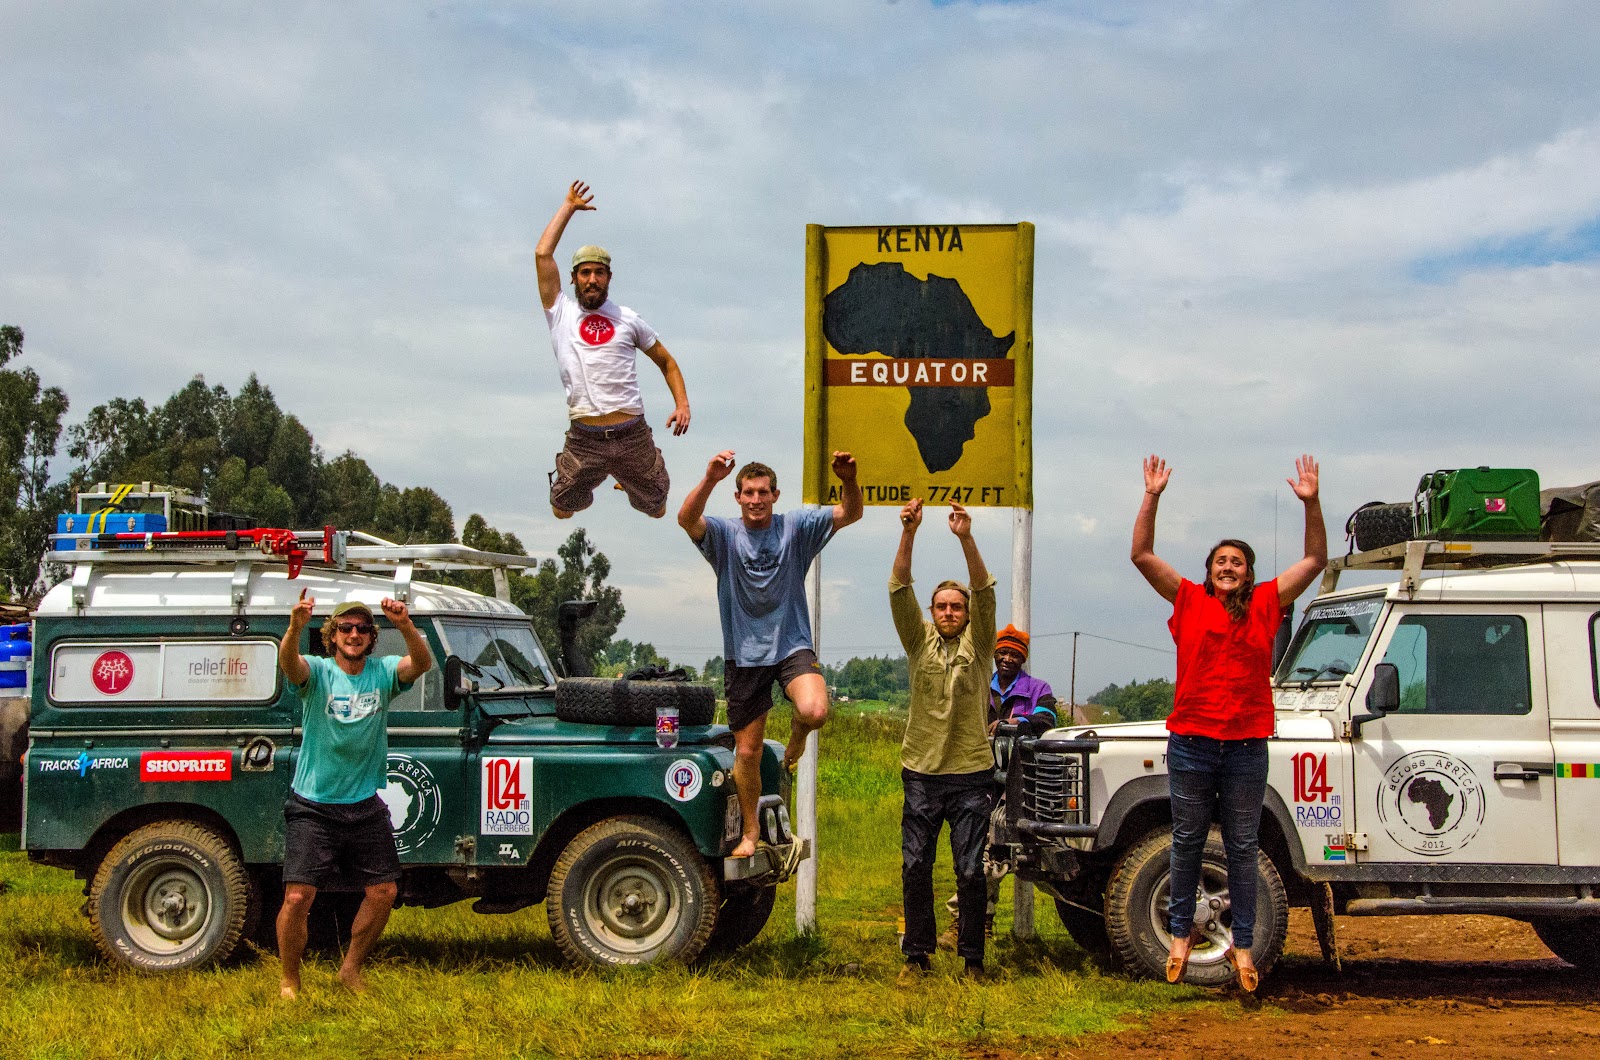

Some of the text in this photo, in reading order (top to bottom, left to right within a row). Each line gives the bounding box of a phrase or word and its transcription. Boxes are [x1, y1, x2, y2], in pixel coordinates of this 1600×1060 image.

[877, 227, 964, 253] KENYA
[850, 362, 989, 384] EQUATOR
[828, 485, 1005, 503] ATUDE 7747 FT
[188, 657, 248, 675] relief.life
[146, 759, 226, 772] SHOPRITE
[398, 762, 433, 796] AFRICA
[485, 758, 527, 810] 104
[1290, 752, 1334, 803] 104
[1436, 760, 1475, 795] AFRICA
[486, 811, 530, 825] RADIO
[1296, 806, 1341, 820] RADIO
[485, 824, 530, 833] TYGERBERG
[1296, 819, 1342, 828] TYGERBERG
[1325, 834, 1344, 846] Tdi
[1422, 840, 1445, 849] 2012
[127, 843, 210, 867] BFGoodrich
[616, 840, 687, 878] All-Terrain
